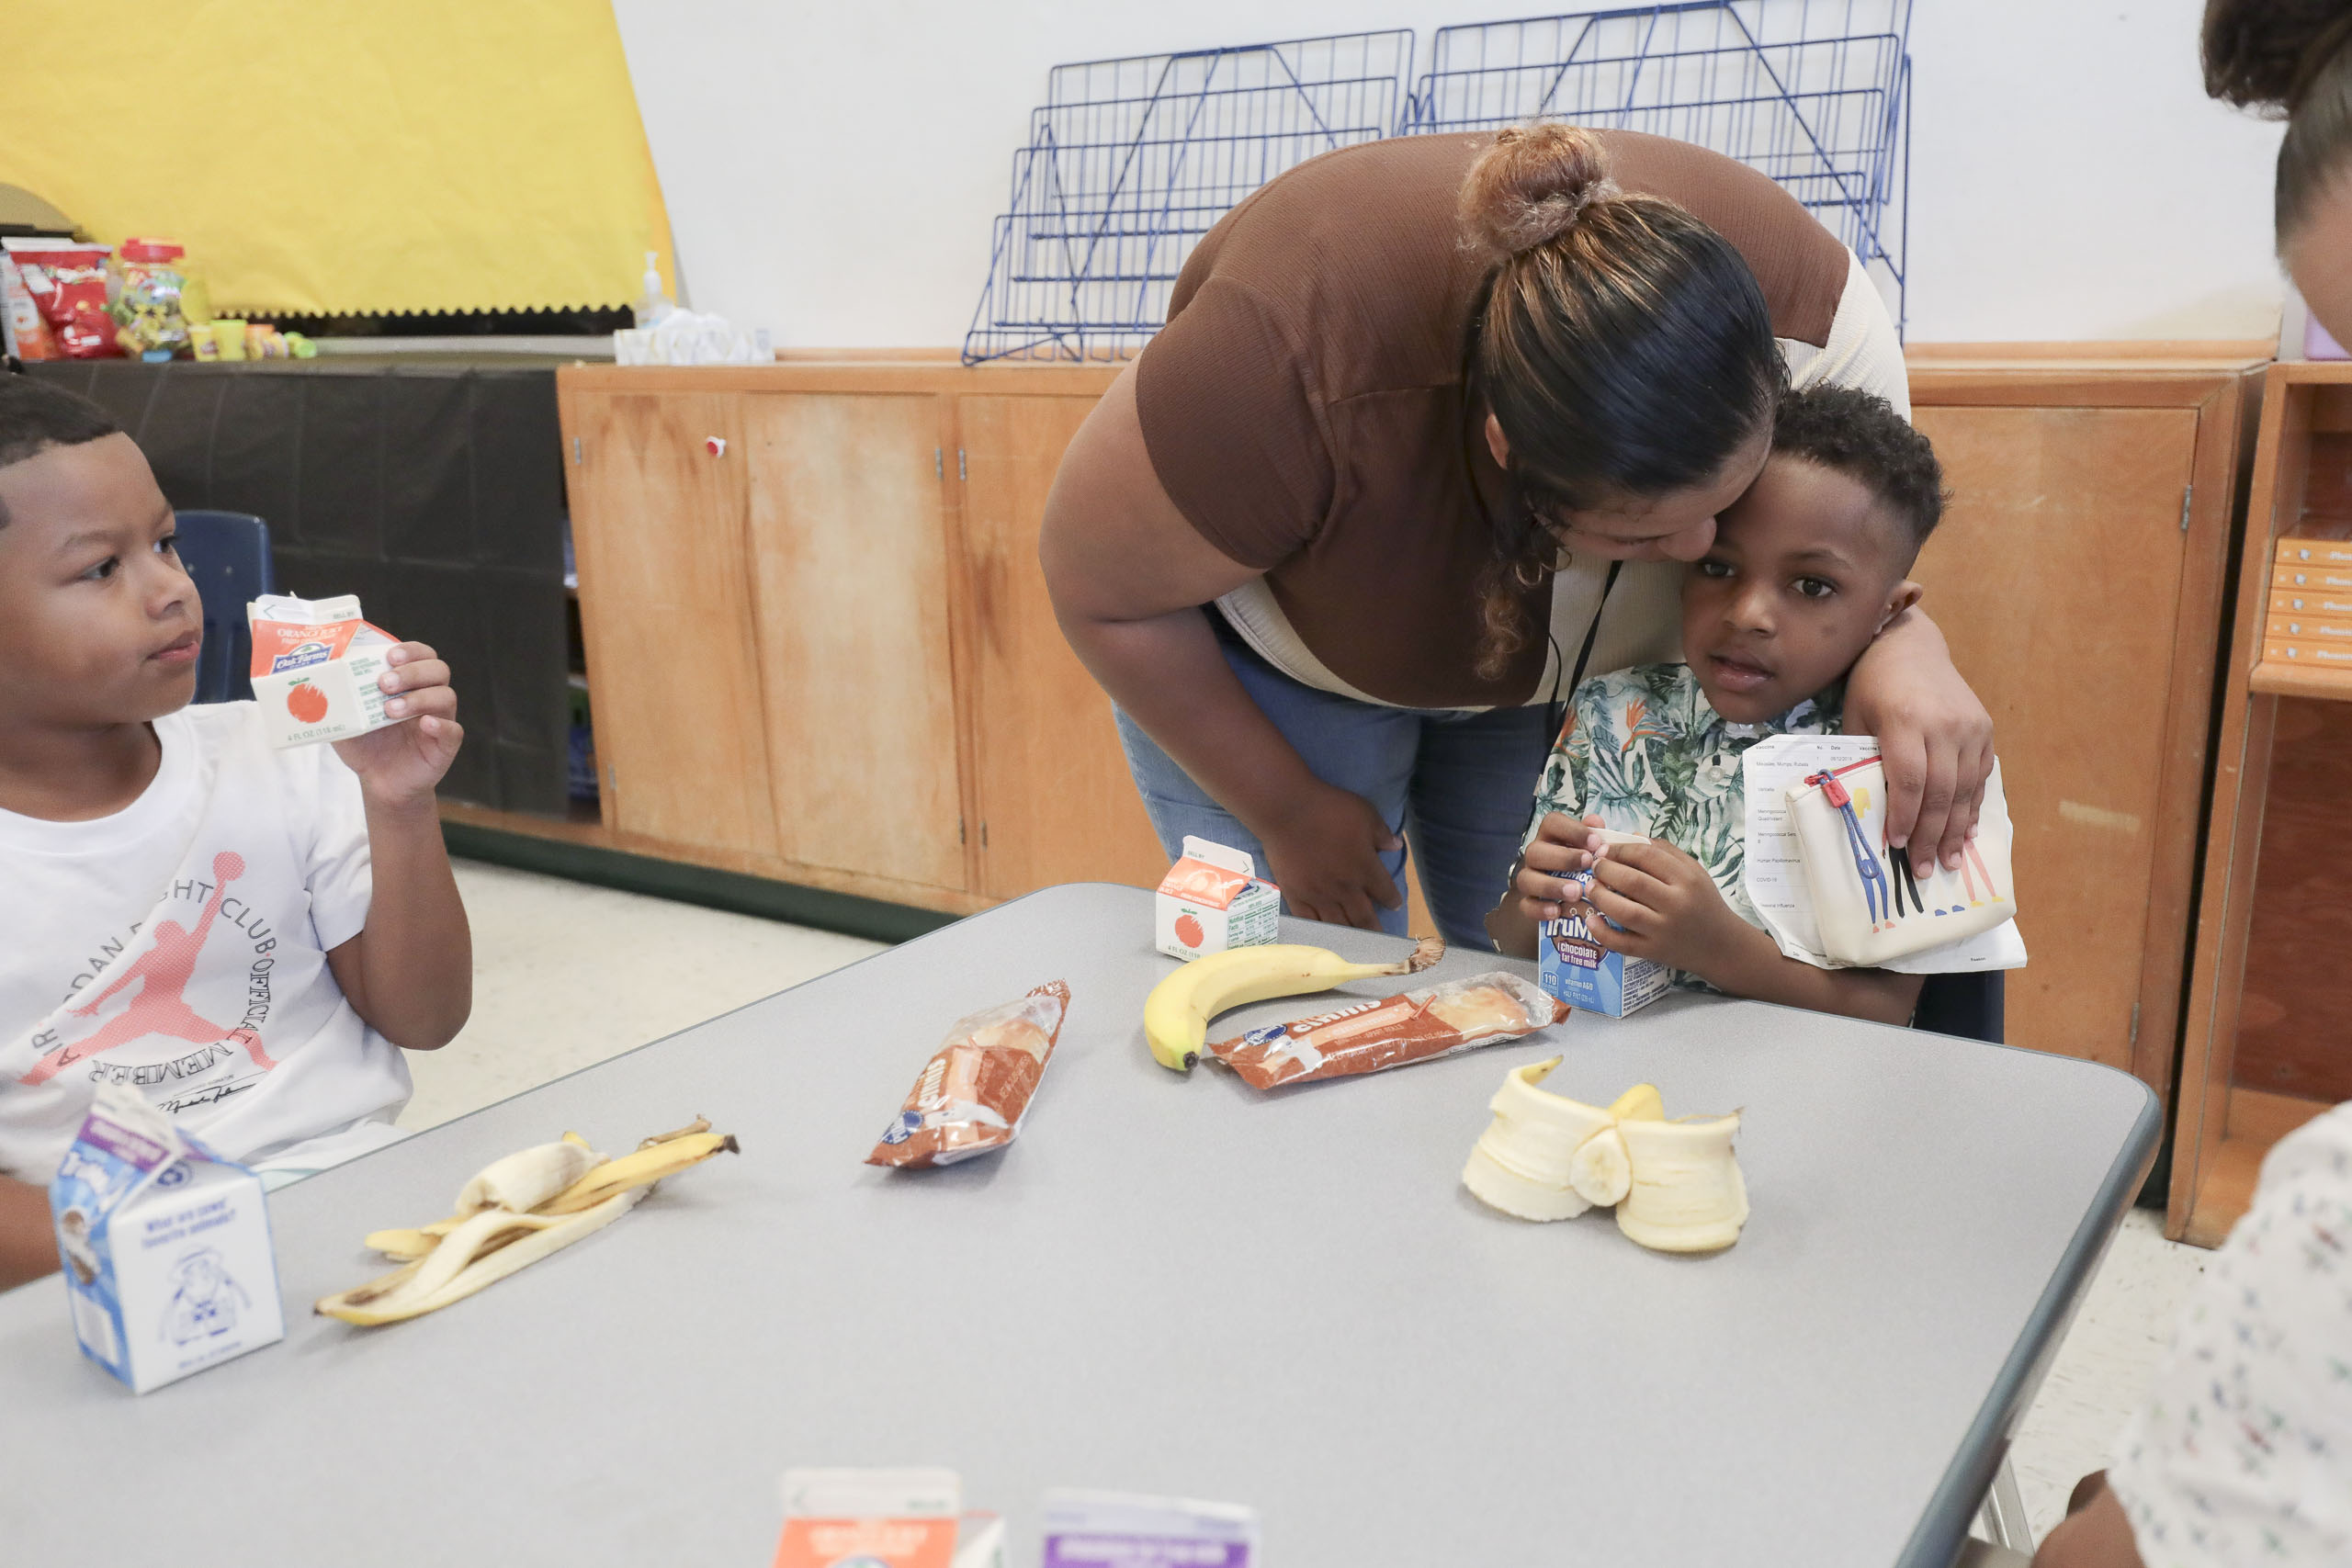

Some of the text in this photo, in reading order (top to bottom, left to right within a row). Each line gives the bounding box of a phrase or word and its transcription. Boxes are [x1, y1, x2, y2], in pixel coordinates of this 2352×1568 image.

[298, 650, 328, 663] Farms
[220, 897, 277, 953] CLUB
[1560, 942, 1598, 960] chocolate
[1561, 953, 1598, 969] fat free milk
[1544, 974, 1556, 986] 110
[1565, 978, 1583, 989] vitamin
[227, 958, 275, 1043] OFFICIAL
[31, 1028, 82, 1067] AIR
[88, 1043, 233, 1086] MEMBER
